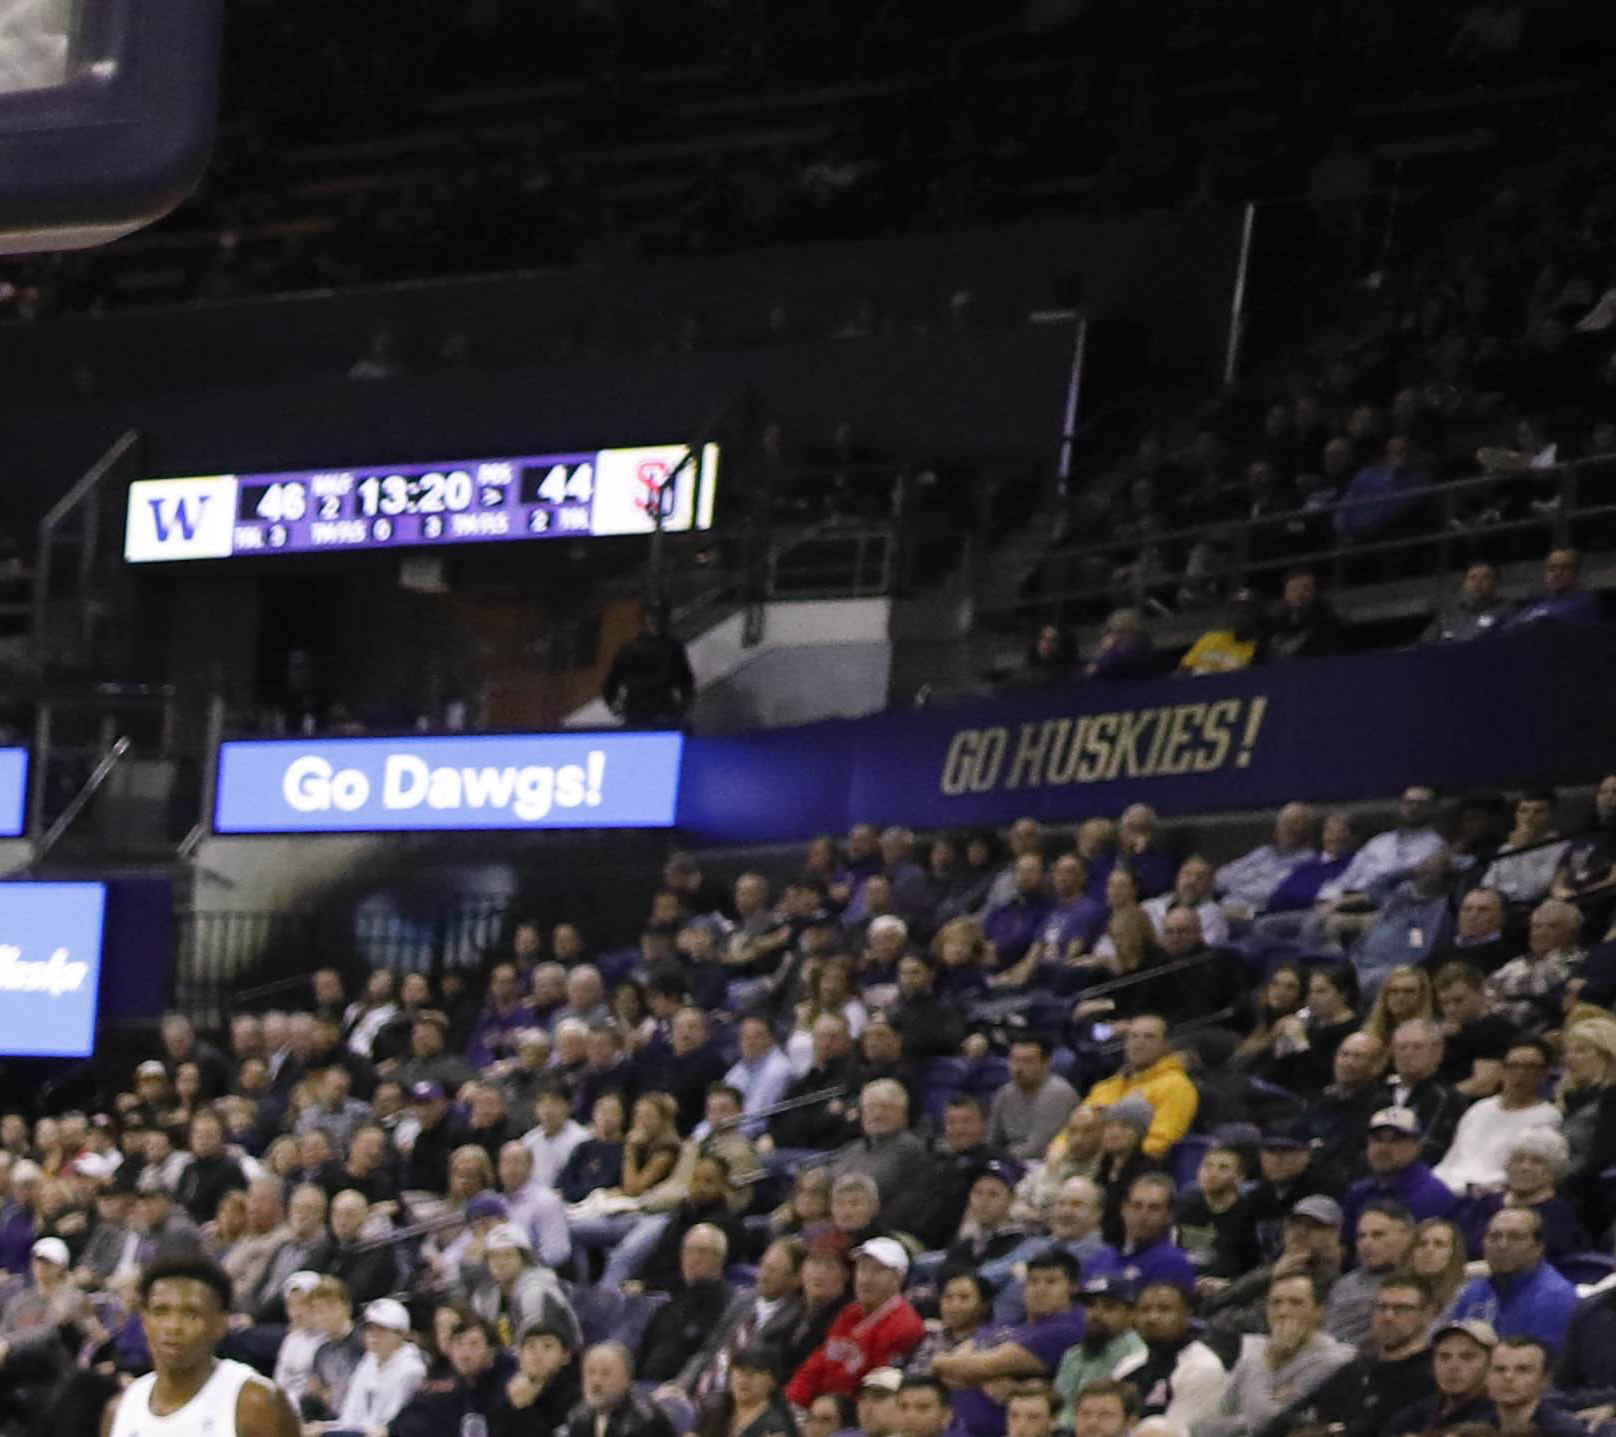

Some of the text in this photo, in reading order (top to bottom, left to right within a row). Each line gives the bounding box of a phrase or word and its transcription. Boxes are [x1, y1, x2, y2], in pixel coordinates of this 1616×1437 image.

[256, 482, 306, 521] 46
[357, 471, 472, 517] 13:20
[538, 463, 593, 504] 44
[148, 494, 212, 542] W
[941, 725, 1008, 796] GO
[282, 751, 605, 821] Go Dawgs!
